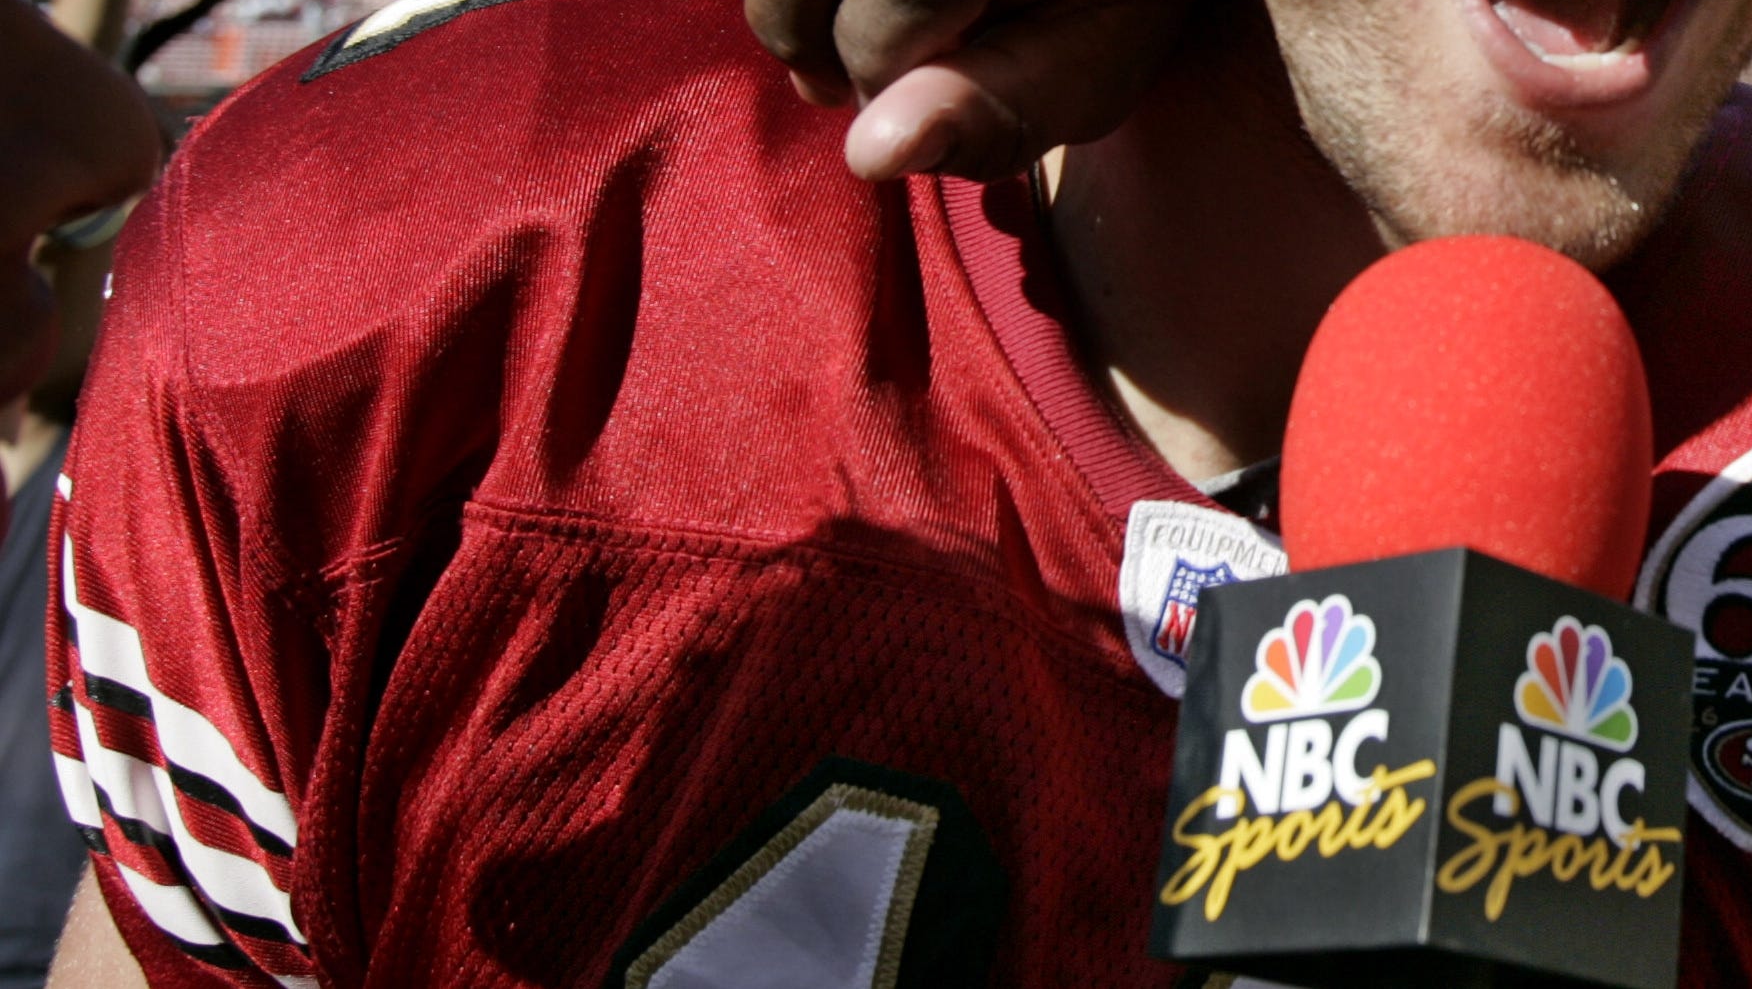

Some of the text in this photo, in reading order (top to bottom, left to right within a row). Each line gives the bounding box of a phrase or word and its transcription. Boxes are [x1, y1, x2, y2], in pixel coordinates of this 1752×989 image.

[1152, 519, 1291, 576] EQUIPMEN
[1216, 708, 1390, 820] NBC
[1493, 721, 1646, 851] NBC
[1159, 758, 1437, 922] Sports
[1437, 776, 1683, 922] Sports
